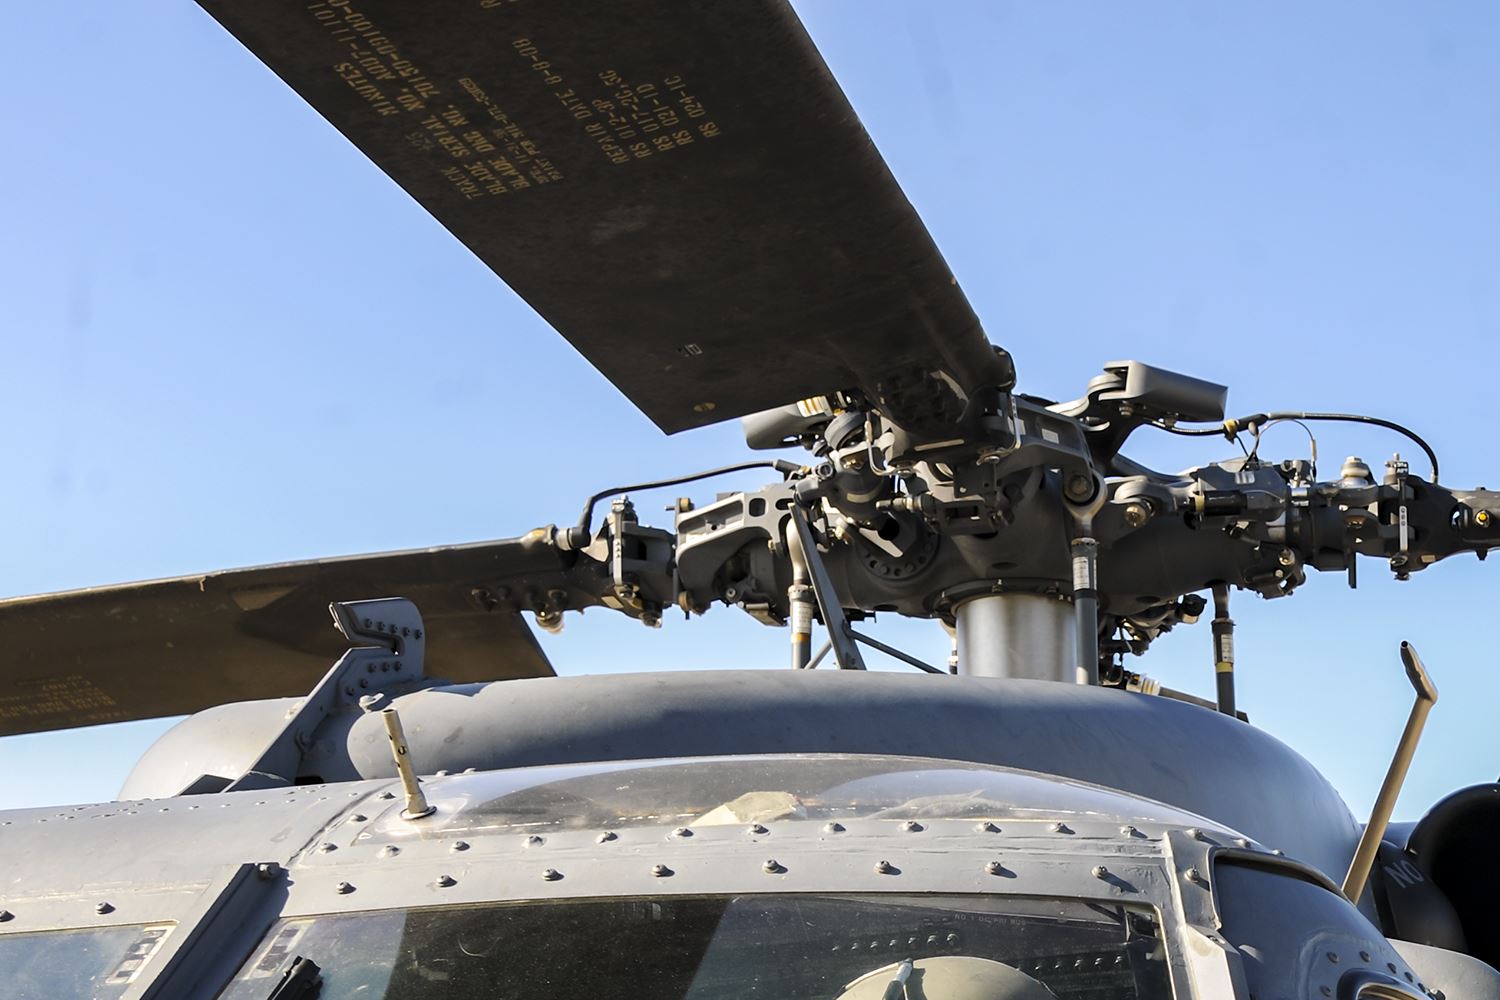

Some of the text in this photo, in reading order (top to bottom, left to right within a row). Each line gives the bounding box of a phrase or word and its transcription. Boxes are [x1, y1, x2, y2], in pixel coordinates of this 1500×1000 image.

[333, 62, 399, 116] MINUTES
[555, 87, 593, 121] DATE
[421, 114, 470, 157] SERIAL
[584, 121, 631, 166] REPAIR
[652, 134, 676, 152] RS
[672, 128, 695, 146] RS
[696, 121, 722, 139] RS
[629, 141, 652, 159] RS
[441, 166, 483, 200] TRACK
[463, 161, 508, 195] BLADE
[487, 155, 531, 190] BLADE
